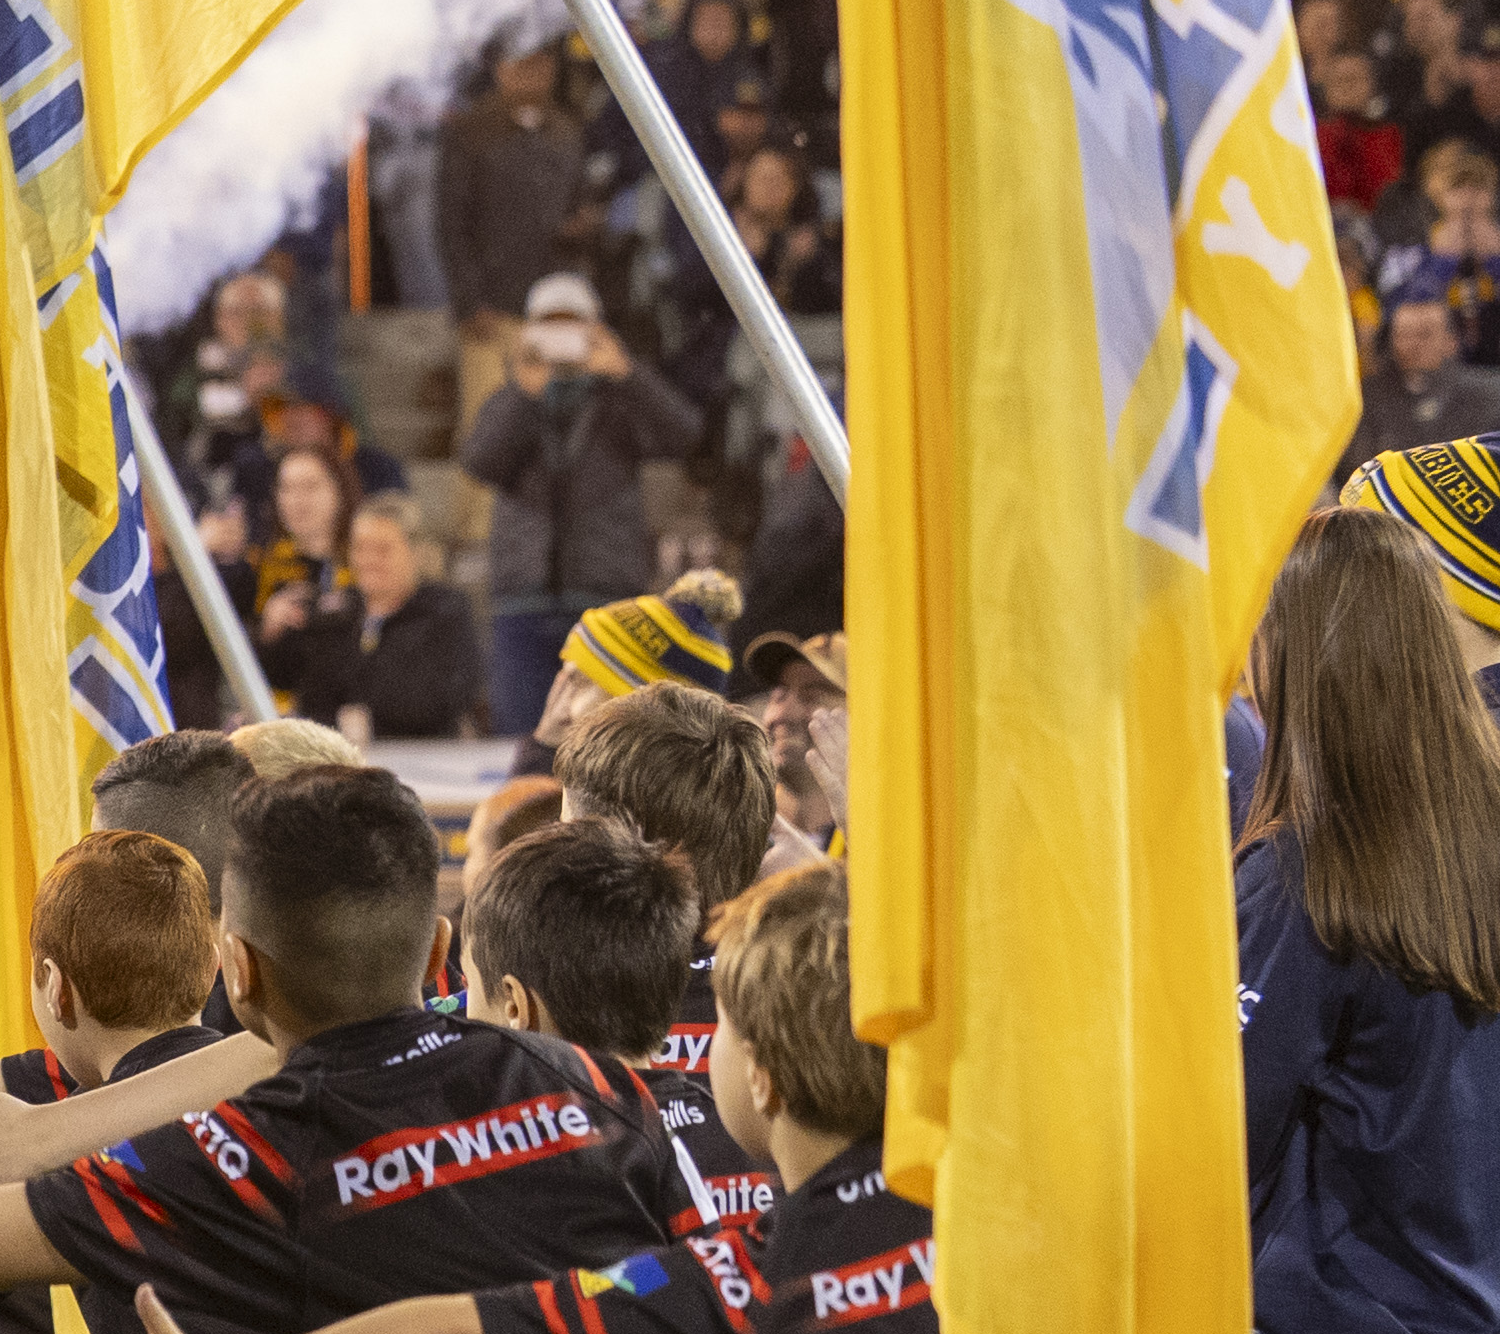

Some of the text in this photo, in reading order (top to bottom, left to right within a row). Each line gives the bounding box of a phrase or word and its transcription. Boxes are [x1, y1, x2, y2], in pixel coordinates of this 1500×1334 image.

[650, 1033, 711, 1071] ay
[705, 1176, 774, 1214] hite
[810, 1261, 904, 1319] Ray
